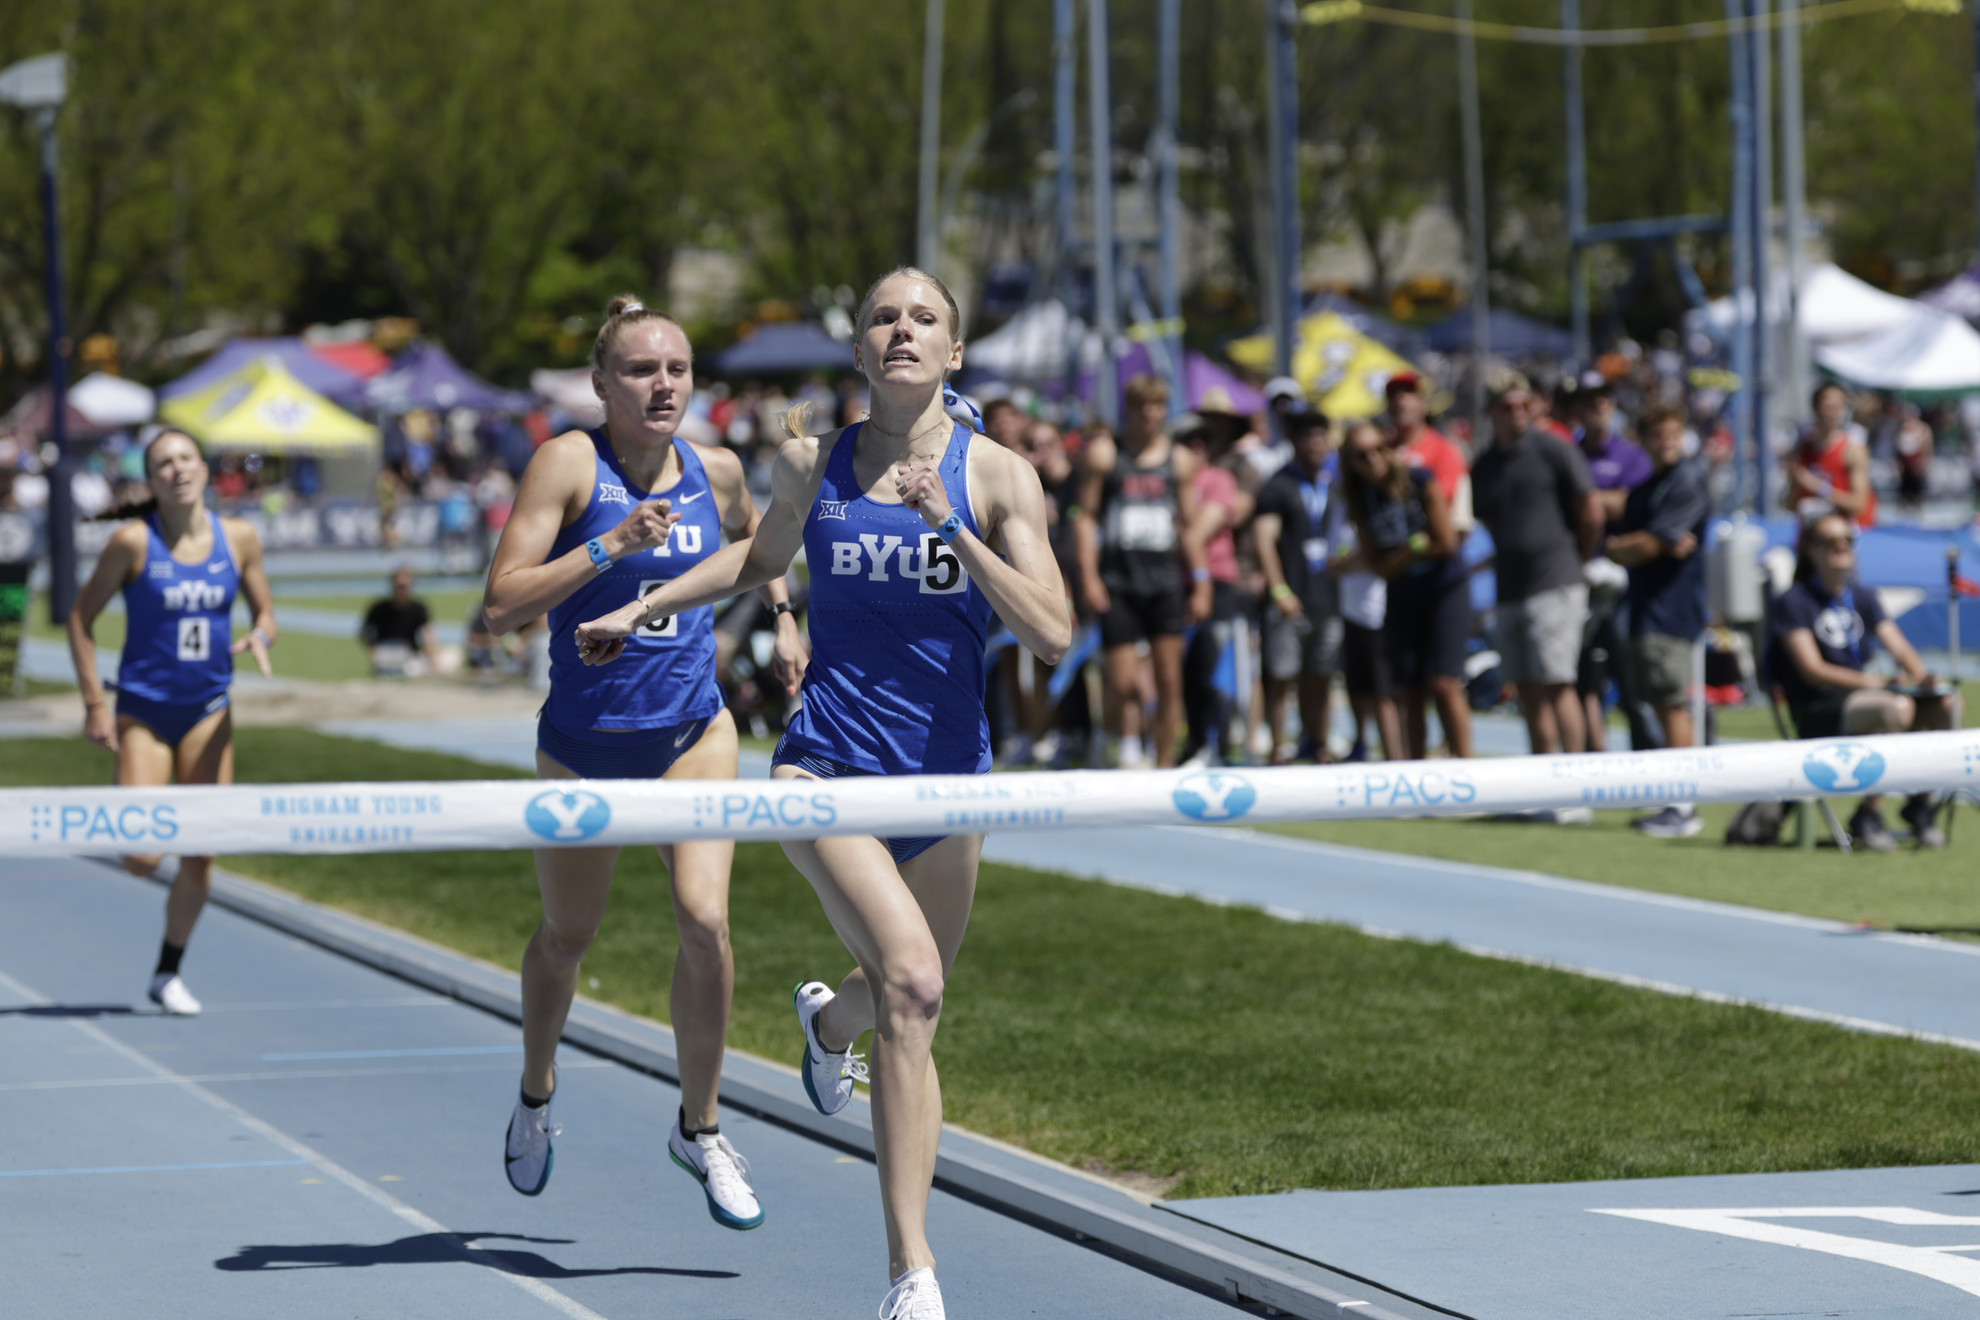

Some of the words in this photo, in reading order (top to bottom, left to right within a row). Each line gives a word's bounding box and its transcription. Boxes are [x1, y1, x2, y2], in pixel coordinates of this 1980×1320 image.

[831, 533, 921, 582] BYU
[926, 537, 960, 590] 5
[163, 580, 225, 612] BYU
[184, 624, 201, 655] 4
[260, 795, 361, 816] BRIGHAM
[373, 793, 443, 815] YOUNG
[1364, 771, 1477, 807] PACS
[60, 804, 179, 841] PACS
[722, 793, 838, 827] PACS
[289, 826, 414, 844] UNIVERSITY
